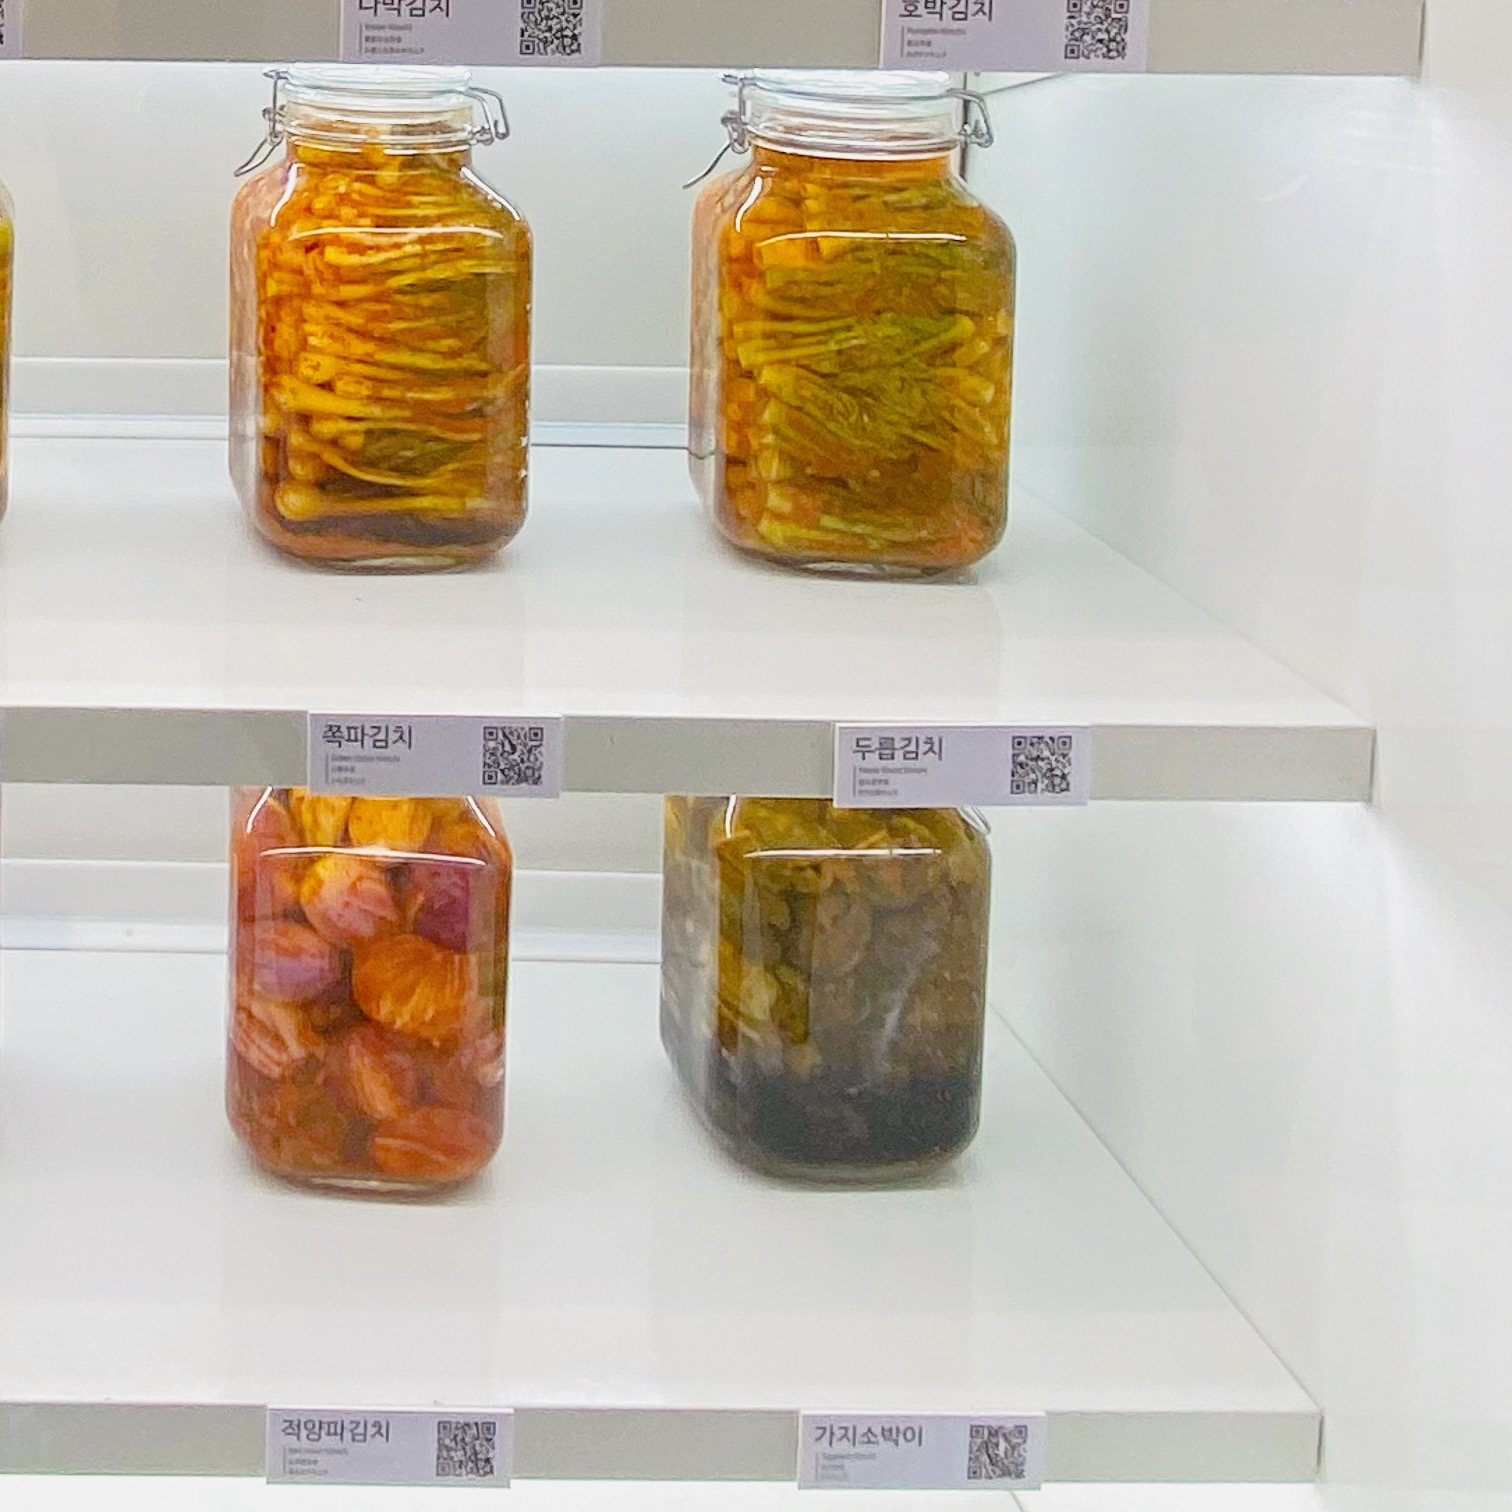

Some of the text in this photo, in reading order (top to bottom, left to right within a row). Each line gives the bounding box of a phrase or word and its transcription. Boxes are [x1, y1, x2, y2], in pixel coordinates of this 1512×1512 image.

[322, 724, 412, 750] 쪽파김치
[852, 736, 943, 761] 두릅김치
[281, 1418, 390, 1443] 적양파김치
[815, 1424, 923, 1447] 가지소박이
